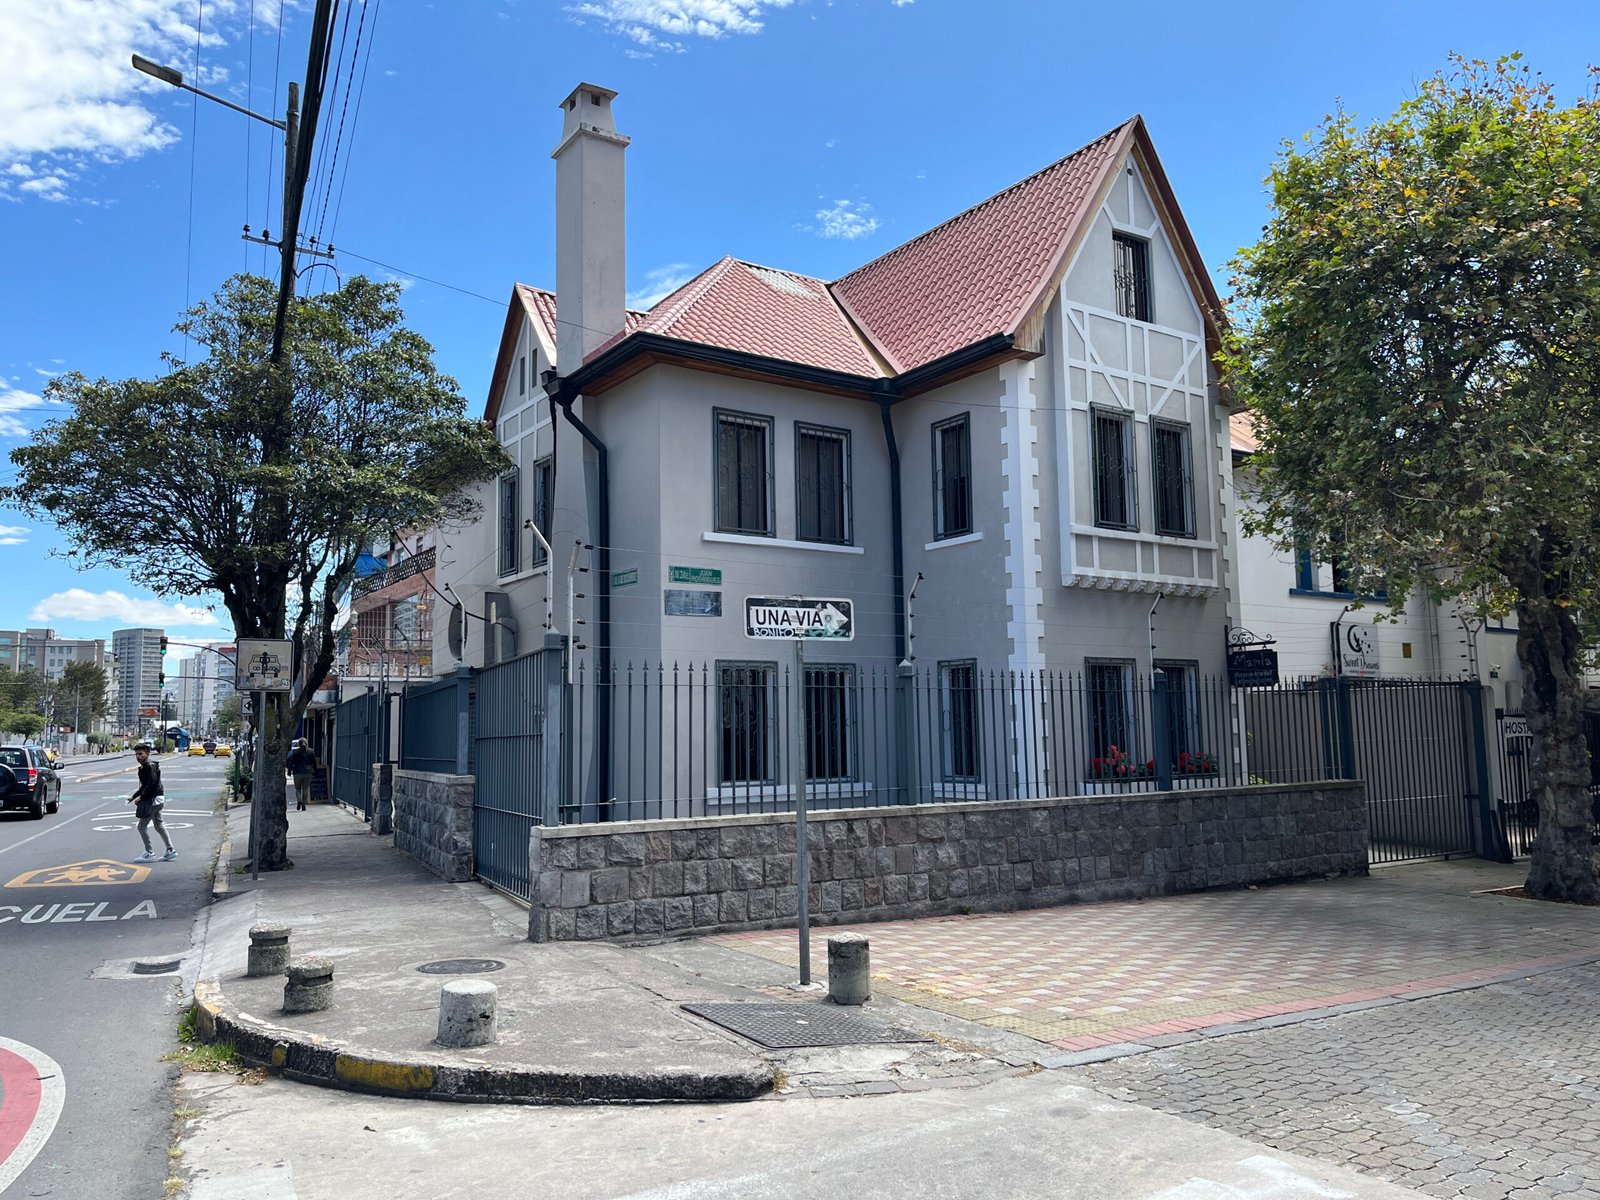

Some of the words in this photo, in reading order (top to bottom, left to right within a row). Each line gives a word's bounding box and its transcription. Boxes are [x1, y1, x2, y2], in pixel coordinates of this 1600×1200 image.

[755, 608, 792, 626] UNA
[795, 610, 824, 627] VIA
[1343, 653, 1359, 668] Sweet
[1359, 651, 1380, 670] Dreams
